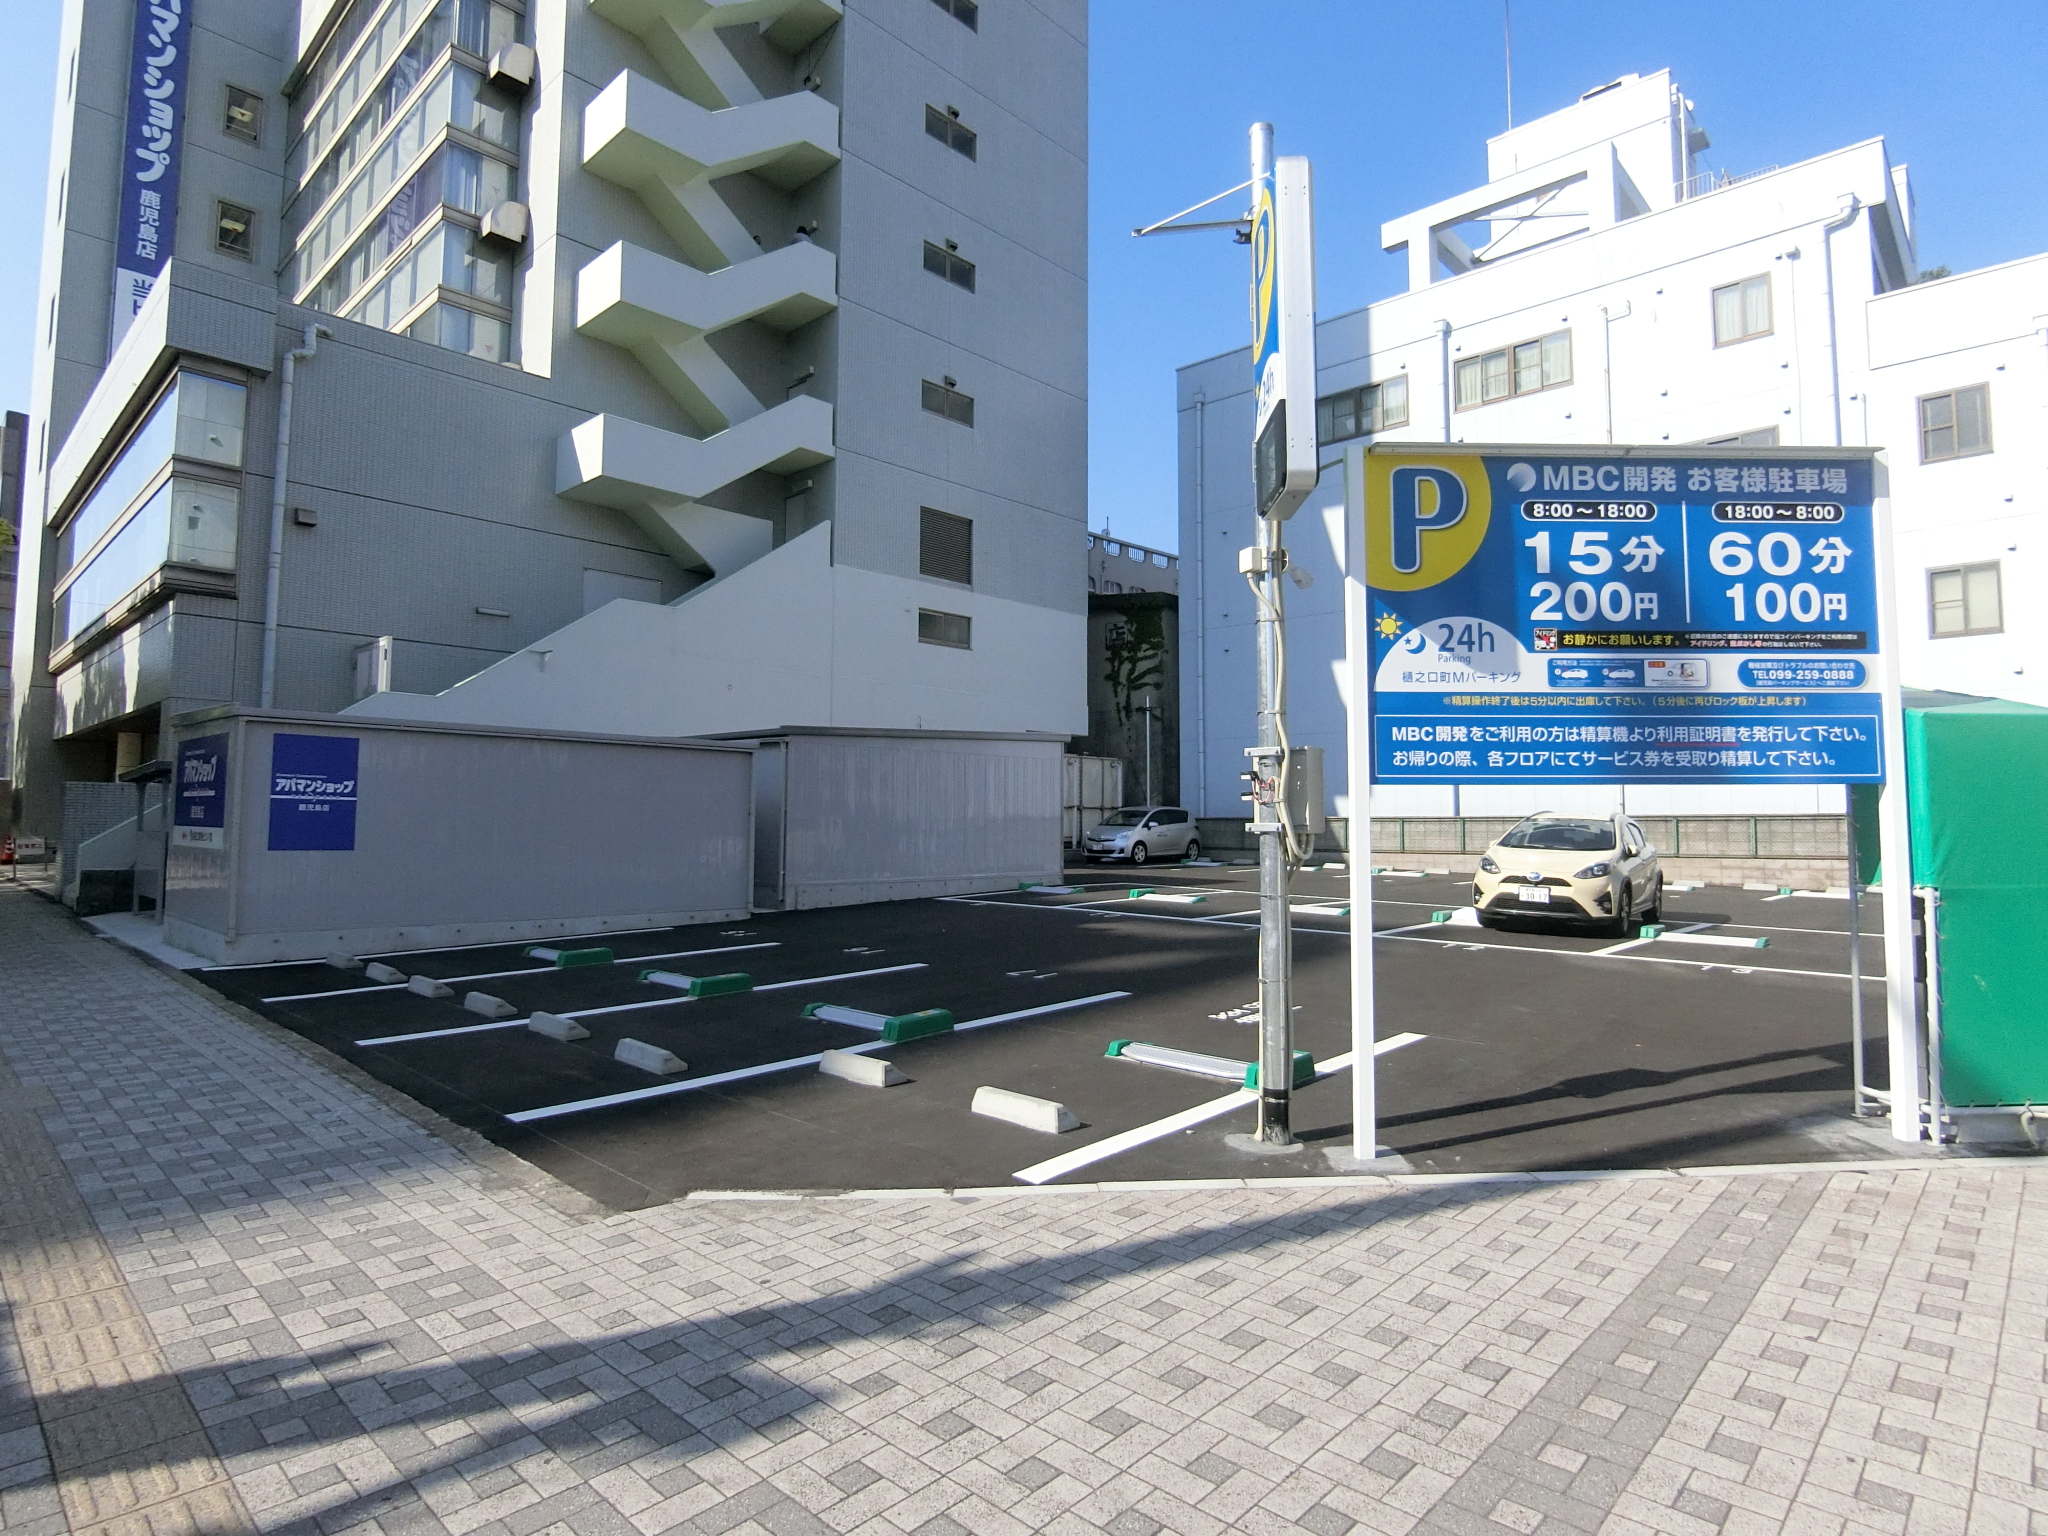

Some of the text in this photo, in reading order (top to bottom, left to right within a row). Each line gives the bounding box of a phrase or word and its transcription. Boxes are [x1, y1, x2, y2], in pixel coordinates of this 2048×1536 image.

[136, 189, 161, 260] 鹿児島店
[1543, 466, 1847, 494] MBC開発 お客様駐車場
[1390, 466, 1467, 573] P
[1709, 532, 1852, 576] 60分
[1530, 581, 1658, 622] 200円
[1726, 583, 1847, 622] 100円
[1437, 622, 1495, 653] 24h
[1562, 633, 1680, 646] お静かにお願いします。
[1437, 653, 1472, 665] Parking
[275, 778, 355, 793] アパマンショップ
